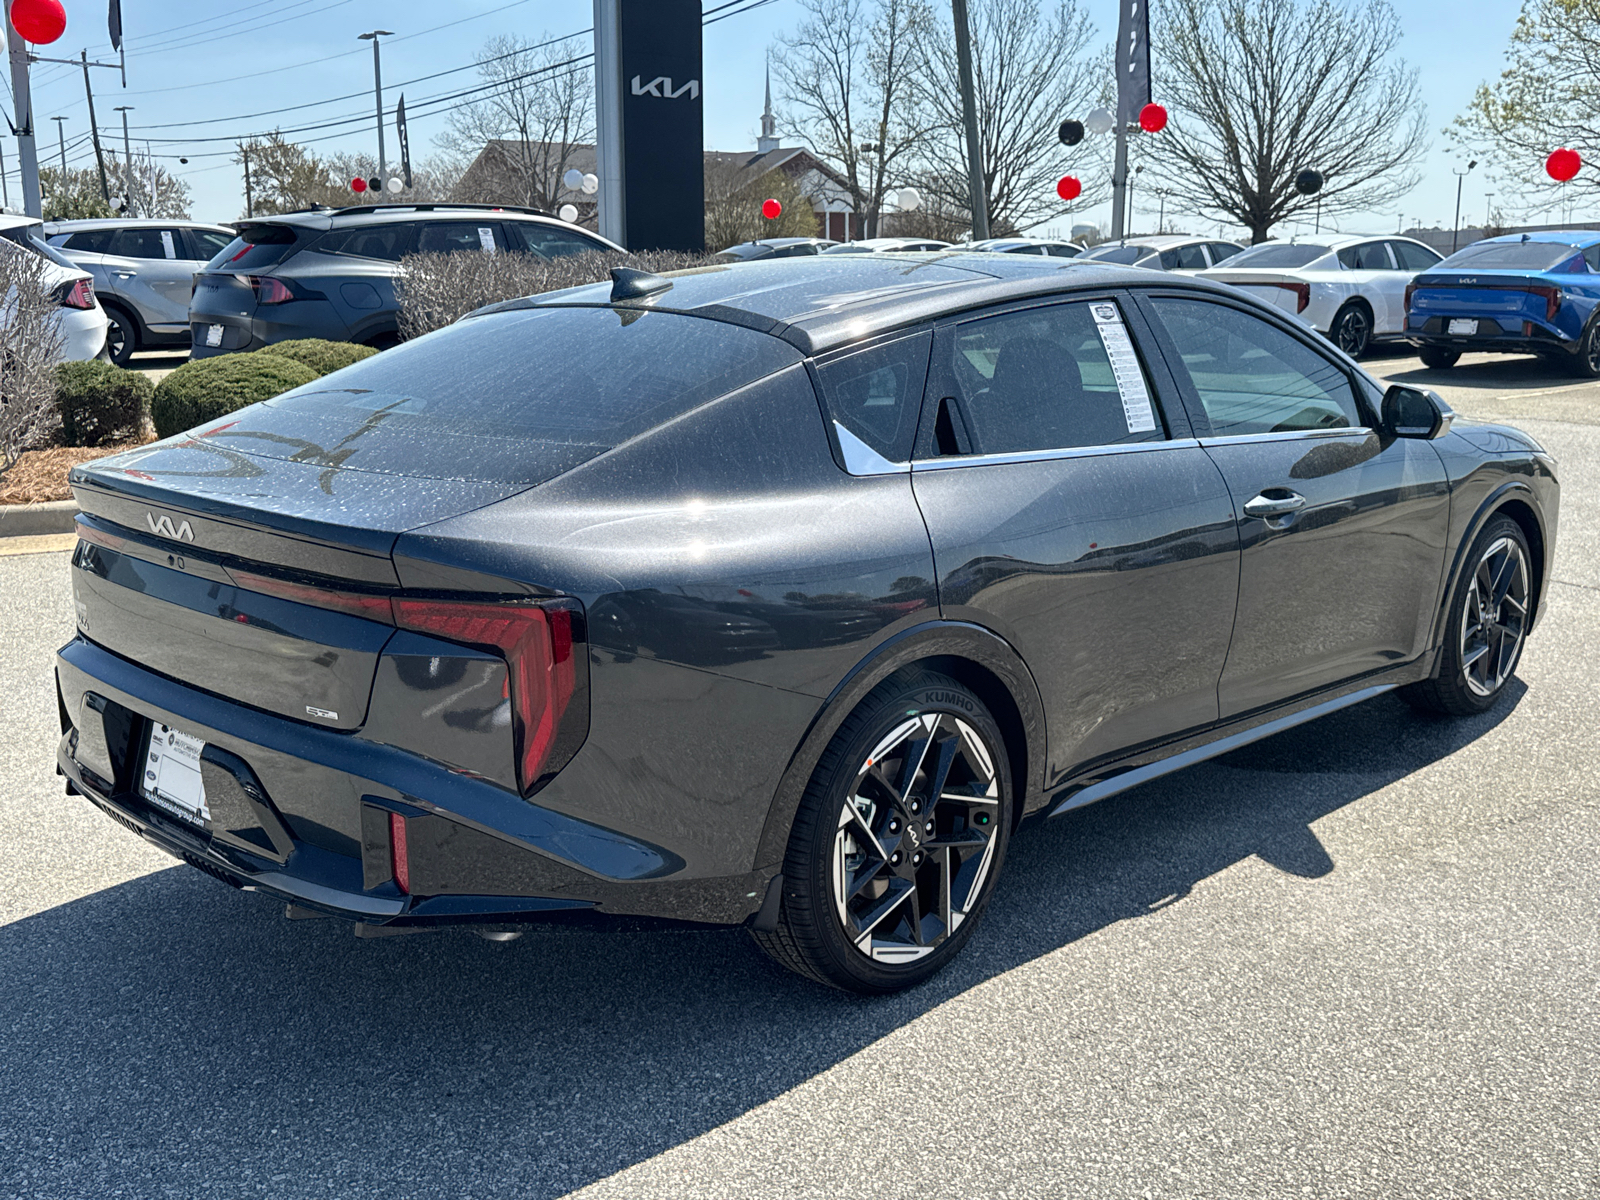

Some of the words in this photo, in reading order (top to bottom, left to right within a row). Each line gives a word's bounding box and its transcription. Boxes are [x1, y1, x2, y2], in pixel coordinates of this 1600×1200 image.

[631, 75, 699, 100] KIA
[146, 511, 195, 542] KIA
[925, 691, 974, 712] KUMHO
